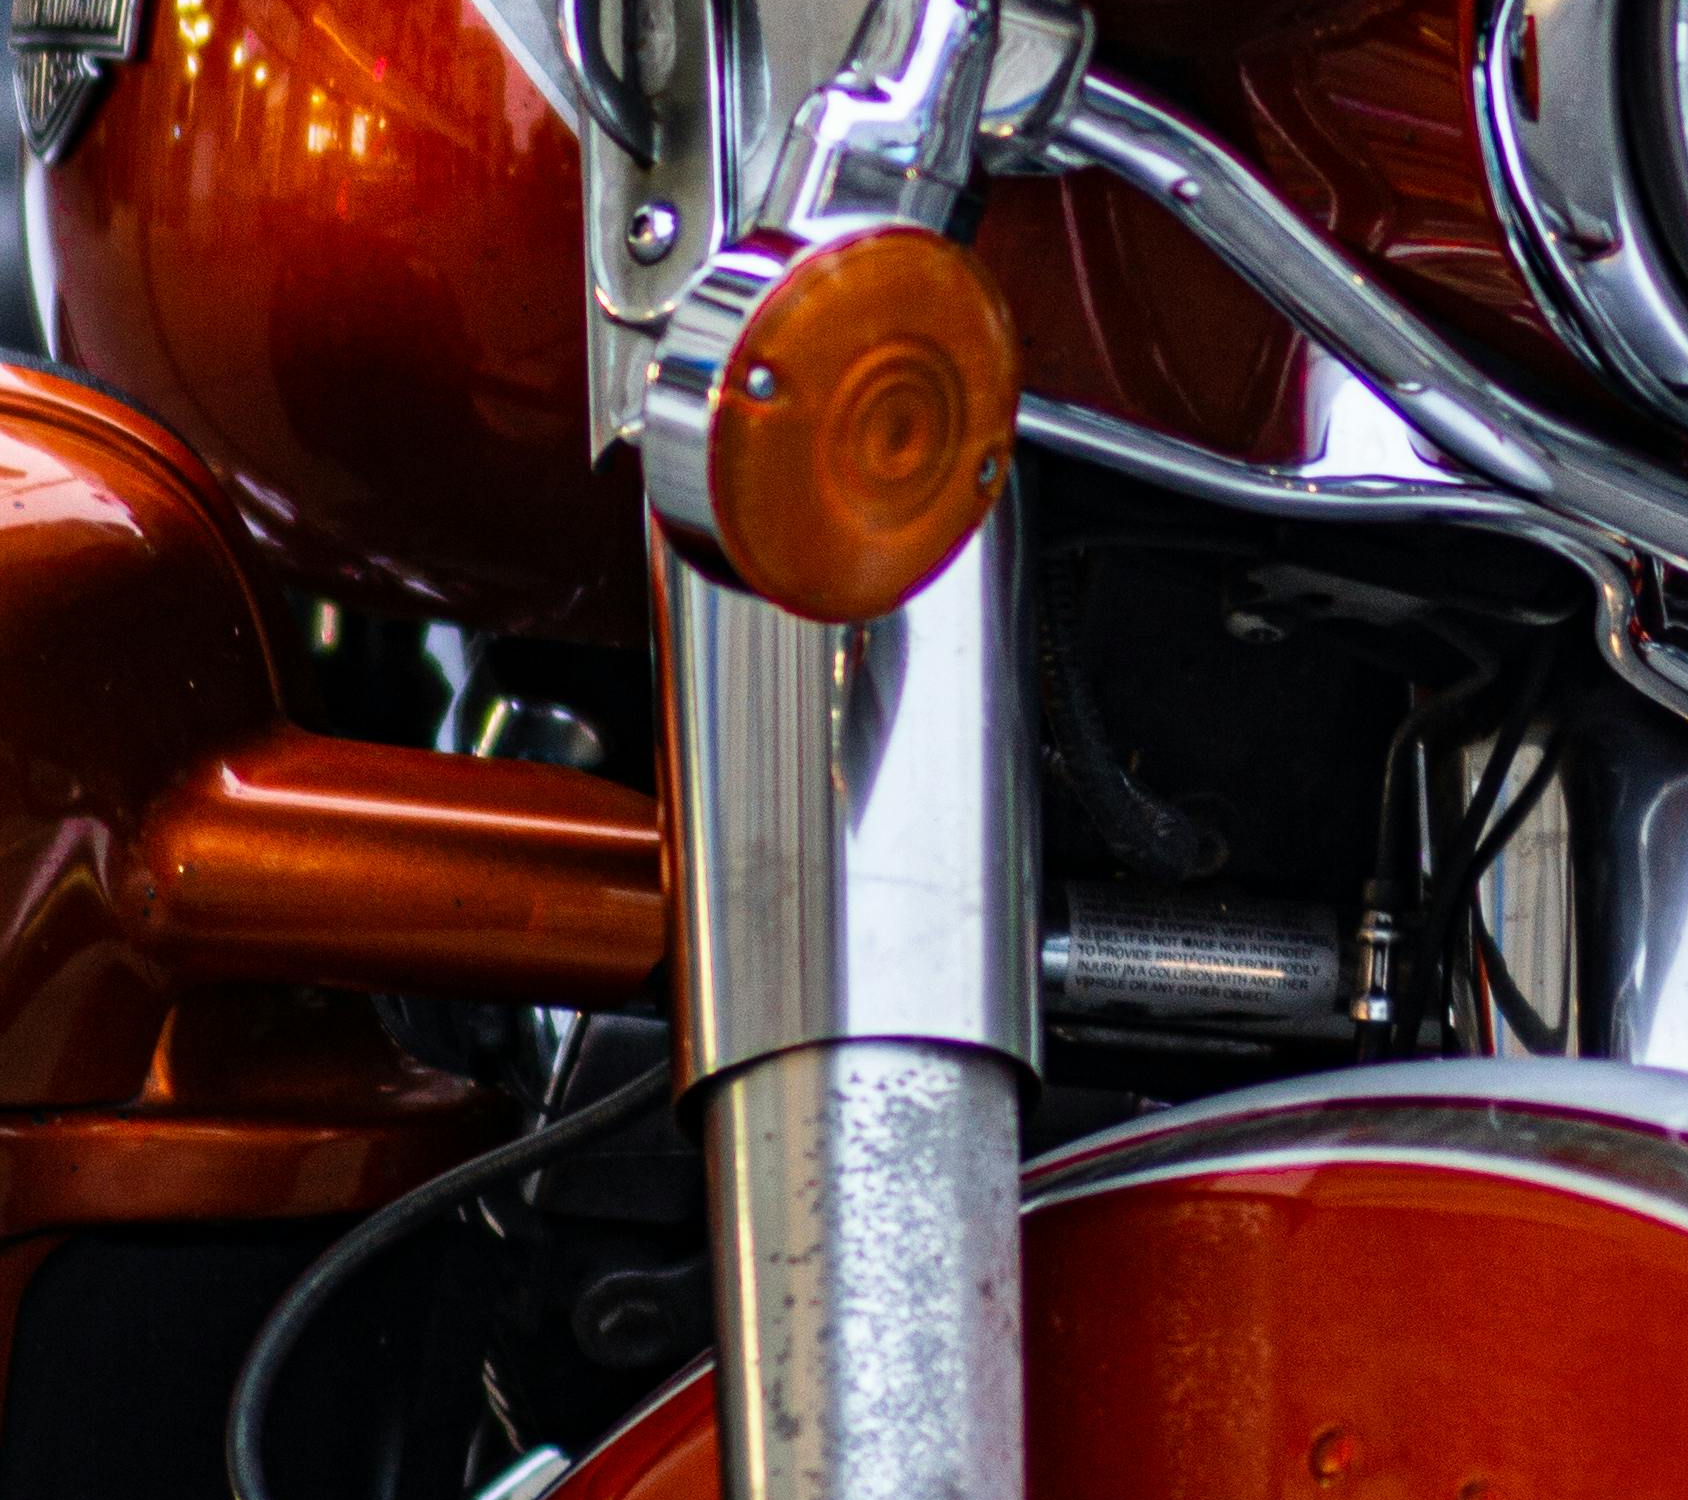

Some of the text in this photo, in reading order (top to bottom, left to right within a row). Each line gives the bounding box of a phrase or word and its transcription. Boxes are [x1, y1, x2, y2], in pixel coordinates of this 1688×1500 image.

[1077, 943, 1319, 977] TO PROVIDE PROTECTION FROM BODILY
[1153, 934, 1176, 947] NOT
[1182, 937, 1213, 951] MADE
[1220, 941, 1245, 954] NOR
[1249, 944, 1310, 961] INTENDED
[1077, 958, 1117, 972] INJURY
[1148, 965, 1212, 982] COLLISION
[1216, 972, 1246, 986] WITH
[1250, 976, 1308, 992] ANOTHER
[1129, 979, 1146, 991] OR
[1149, 981, 1172, 994] ANY
[1176, 984, 1219, 999] OTHER
